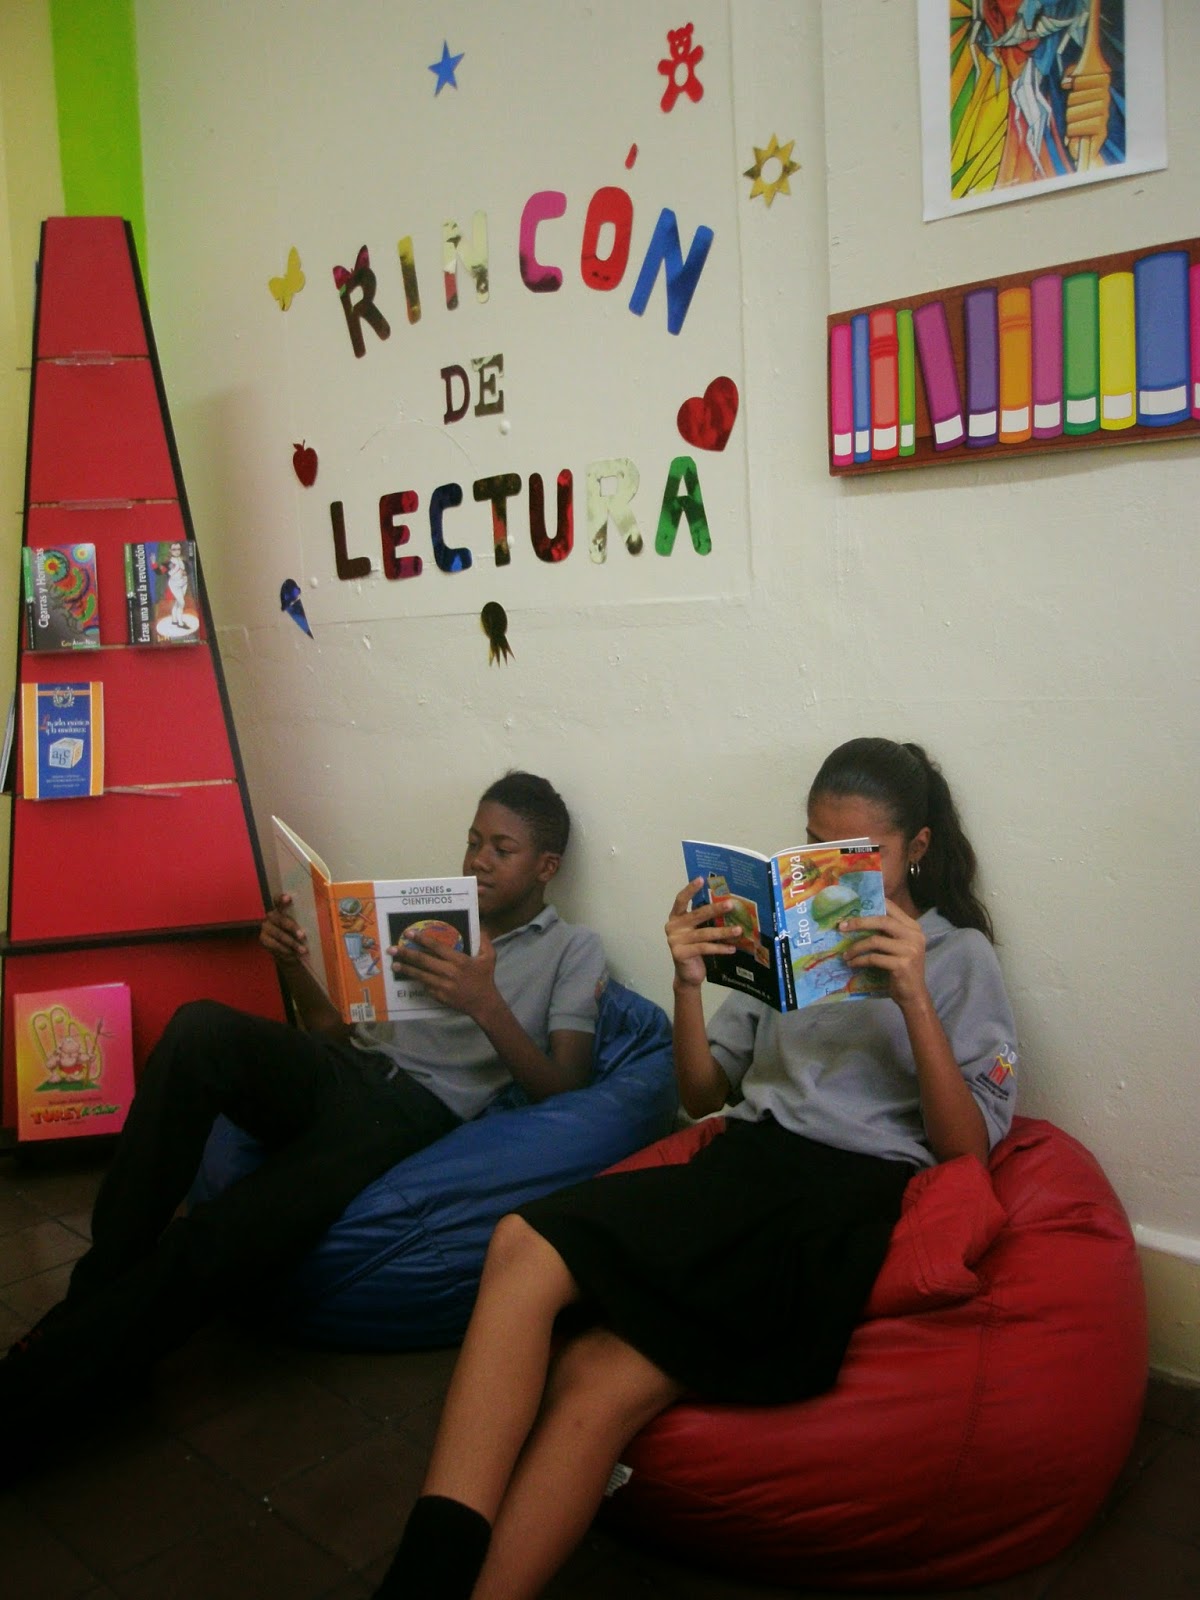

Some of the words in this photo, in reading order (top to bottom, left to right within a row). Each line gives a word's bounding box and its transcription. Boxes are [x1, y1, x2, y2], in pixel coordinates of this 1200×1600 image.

[333, 143, 715, 358] RINCÓN
[440, 353, 505, 425] DE
[330, 455, 713, 582] LECTURA
[35, 547, 46, 586] Hormigas
[134, 544, 147, 583] revolución
[137, 584, 147, 592] la
[38, 595, 50, 628] Cigarras
[141, 606, 149, 622] una
[789, 855, 806, 898] Troya
[796, 901, 808, 914] es
[797, 918, 812, 947] Esto
